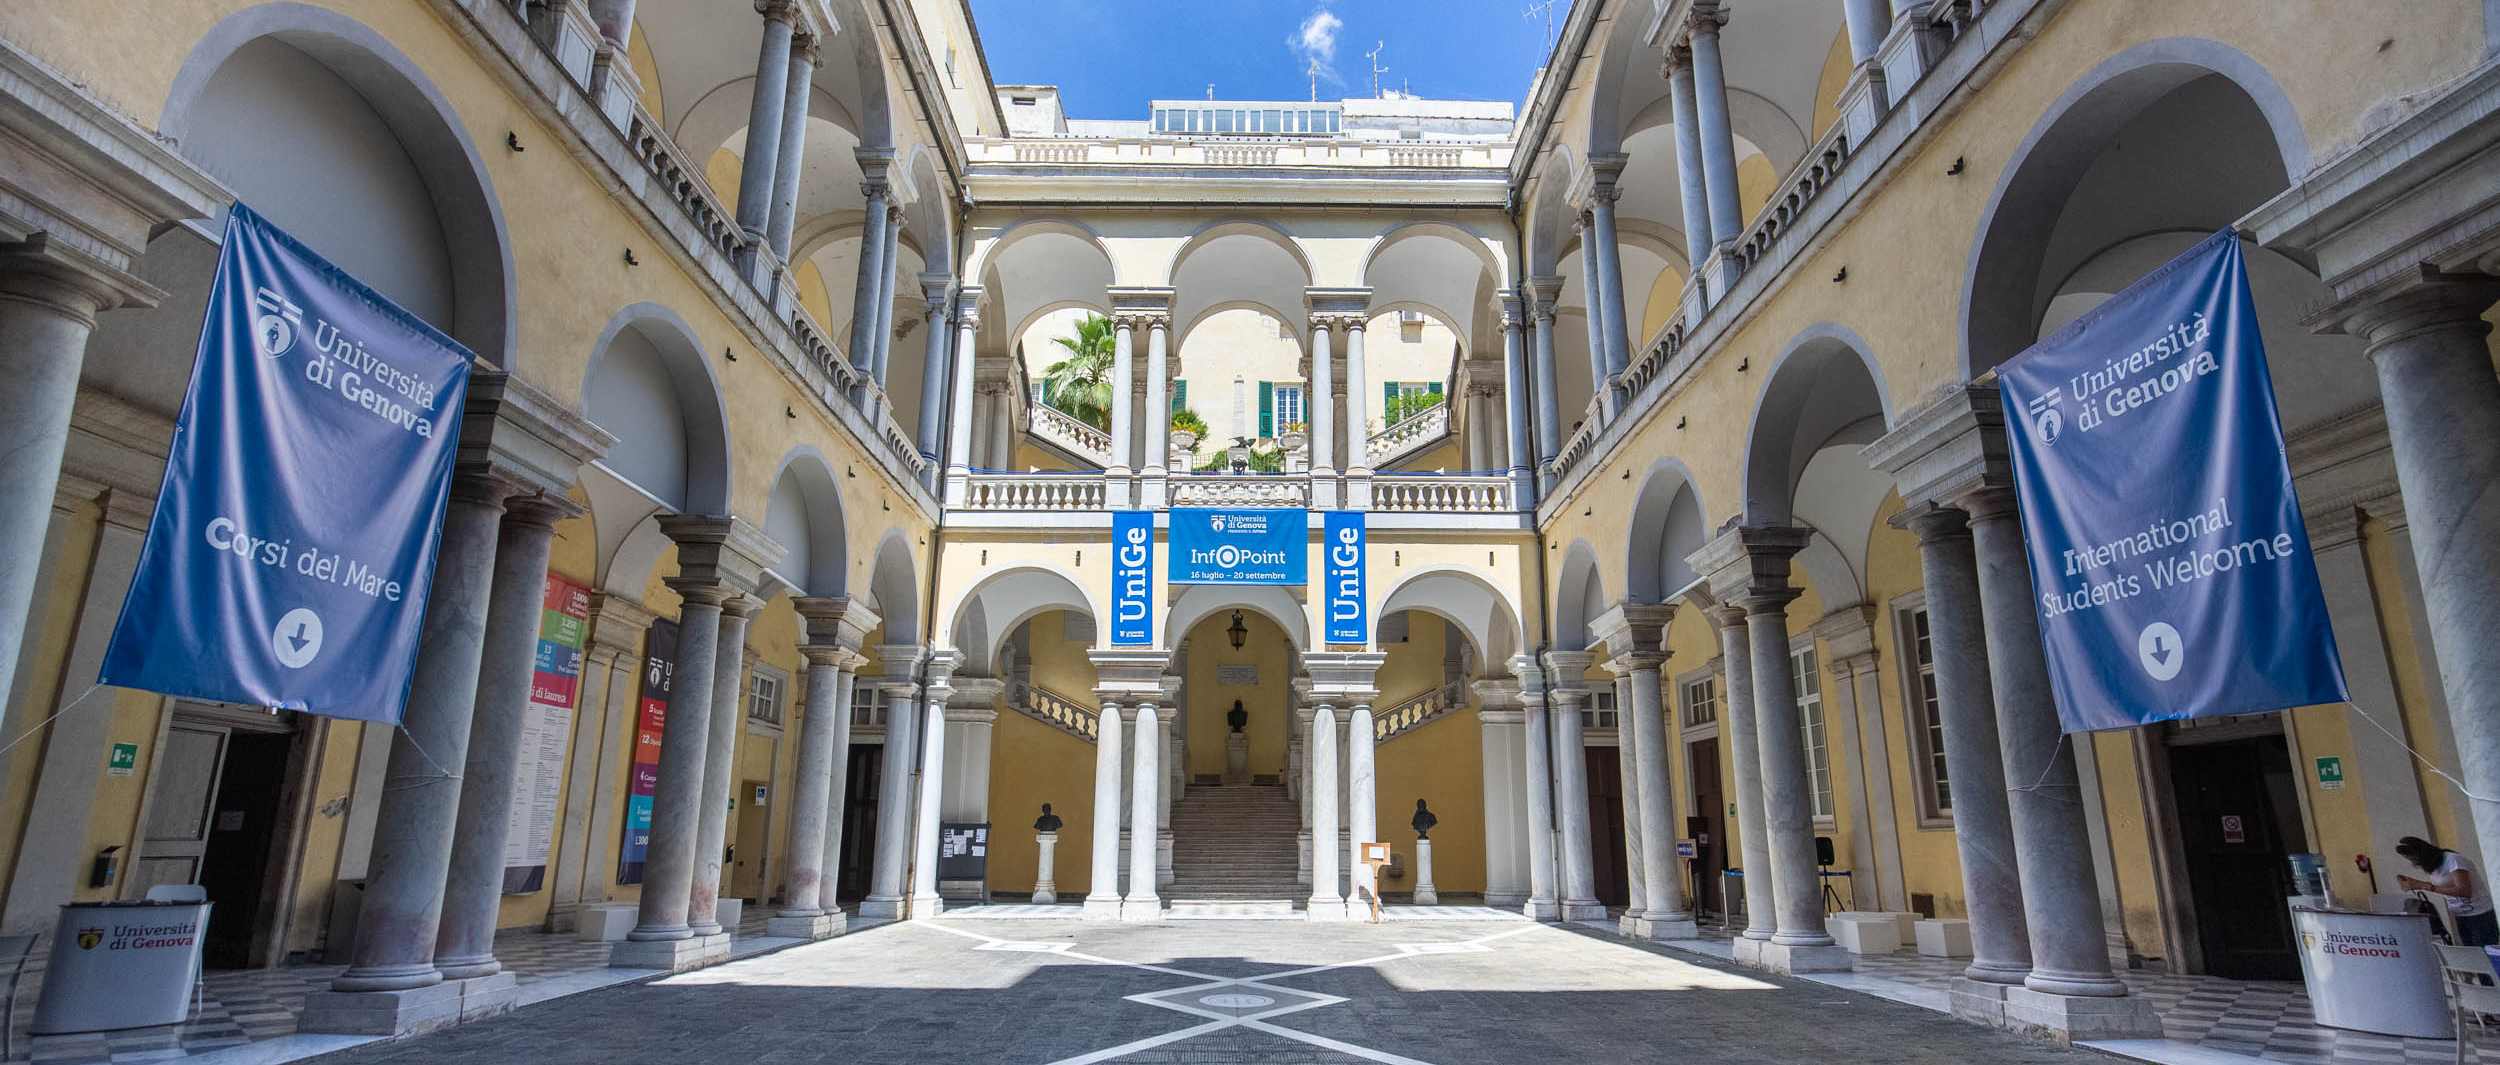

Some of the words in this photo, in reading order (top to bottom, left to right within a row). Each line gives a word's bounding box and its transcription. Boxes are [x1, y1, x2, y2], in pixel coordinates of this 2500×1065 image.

[305, 354, 335, 390] di
[341, 371, 432, 439] Genova
[314, 319, 435, 411] Università
[2070, 312, 2210, 401] Università
[2078, 398, 2103, 432] di
[2106, 351, 2219, 417] Genova
[1227, 514, 1266, 522] Università
[1227, 521, 1236, 529] di
[1236, 521, 1267, 529] Genova
[2063, 497, 2232, 577] International
[205, 517, 290, 569] Corsi
[297, 547, 339, 583] del
[343, 560, 401, 601] Mare
[1119, 527, 1146, 623] UniGe
[1191, 571, 1200, 579] 16
[1201, 571, 1224, 580] luglio
[1233, 571, 1244, 579] 20
[1245, 571, 1286, 579] settembre
[1332, 527, 1360, 623] UniGe
[2042, 574, 2141, 618] Students
[2145, 532, 2294, 590] Welcome
[110, 937, 128, 950] di
[132, 937, 193, 949] Genova
[114, 922, 196, 937] Università
[2321, 931, 2398, 946] Università
[2323, 943, 2336, 954] di
[2338, 944, 2401, 958] Genova
